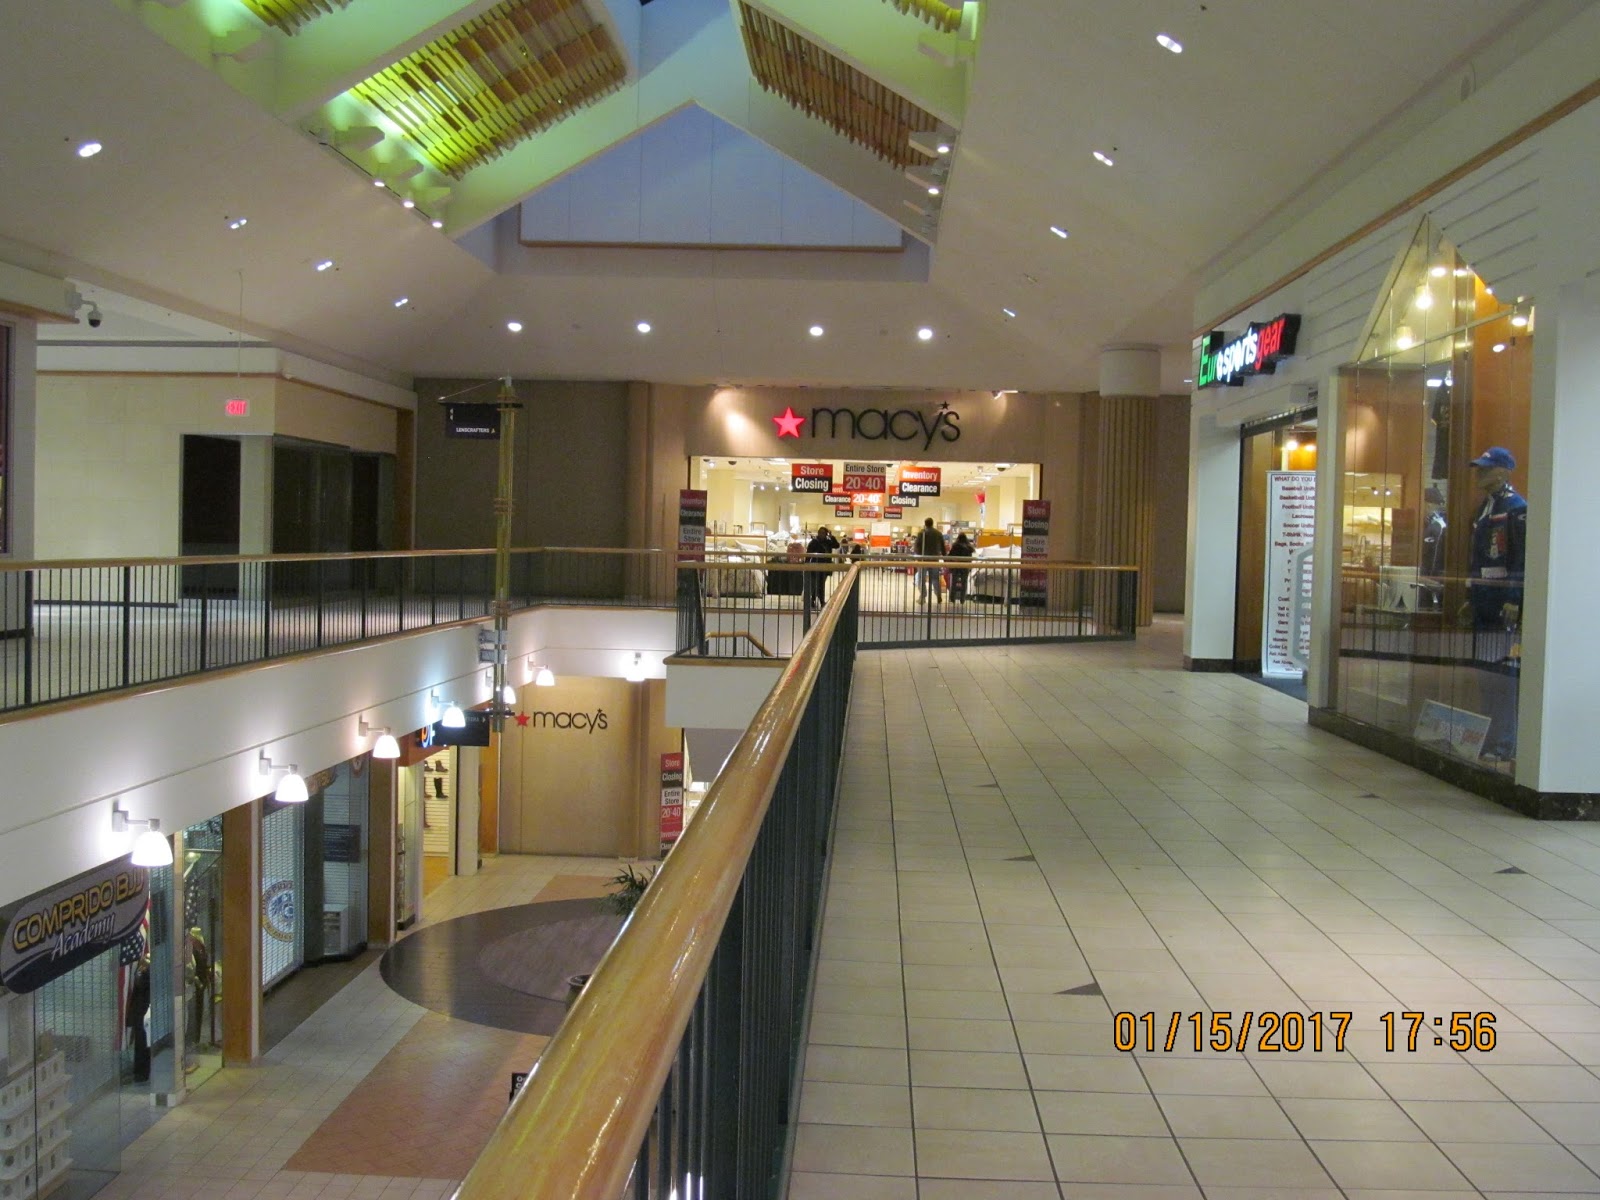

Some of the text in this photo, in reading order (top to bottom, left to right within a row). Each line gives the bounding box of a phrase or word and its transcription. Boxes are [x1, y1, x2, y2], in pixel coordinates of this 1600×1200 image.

[227, 401, 246, 415] EXIT
[811, 401, 961, 451] macy's
[800, 465, 825, 476] Store
[845, 464, 885, 474] Entire Store
[902, 470, 938, 482] Inventory
[795, 477, 829, 492] Closing
[901, 483, 938, 493] Clearance
[825, 496, 851, 504] Clearance
[891, 496, 917, 506] Closing
[1027, 505, 1046, 515] Store
[1023, 520, 1049, 530] Closing
[683, 527, 702, 535] Entire
[533, 708, 608, 734] macy's
[665, 759, 680, 768] Store
[662, 772, 683, 782] Closing
[664, 790, 681, 798] Entire
[12, 868, 145, 953] COMPRIDO BJJ
[52, 912, 116, 960] Academy
